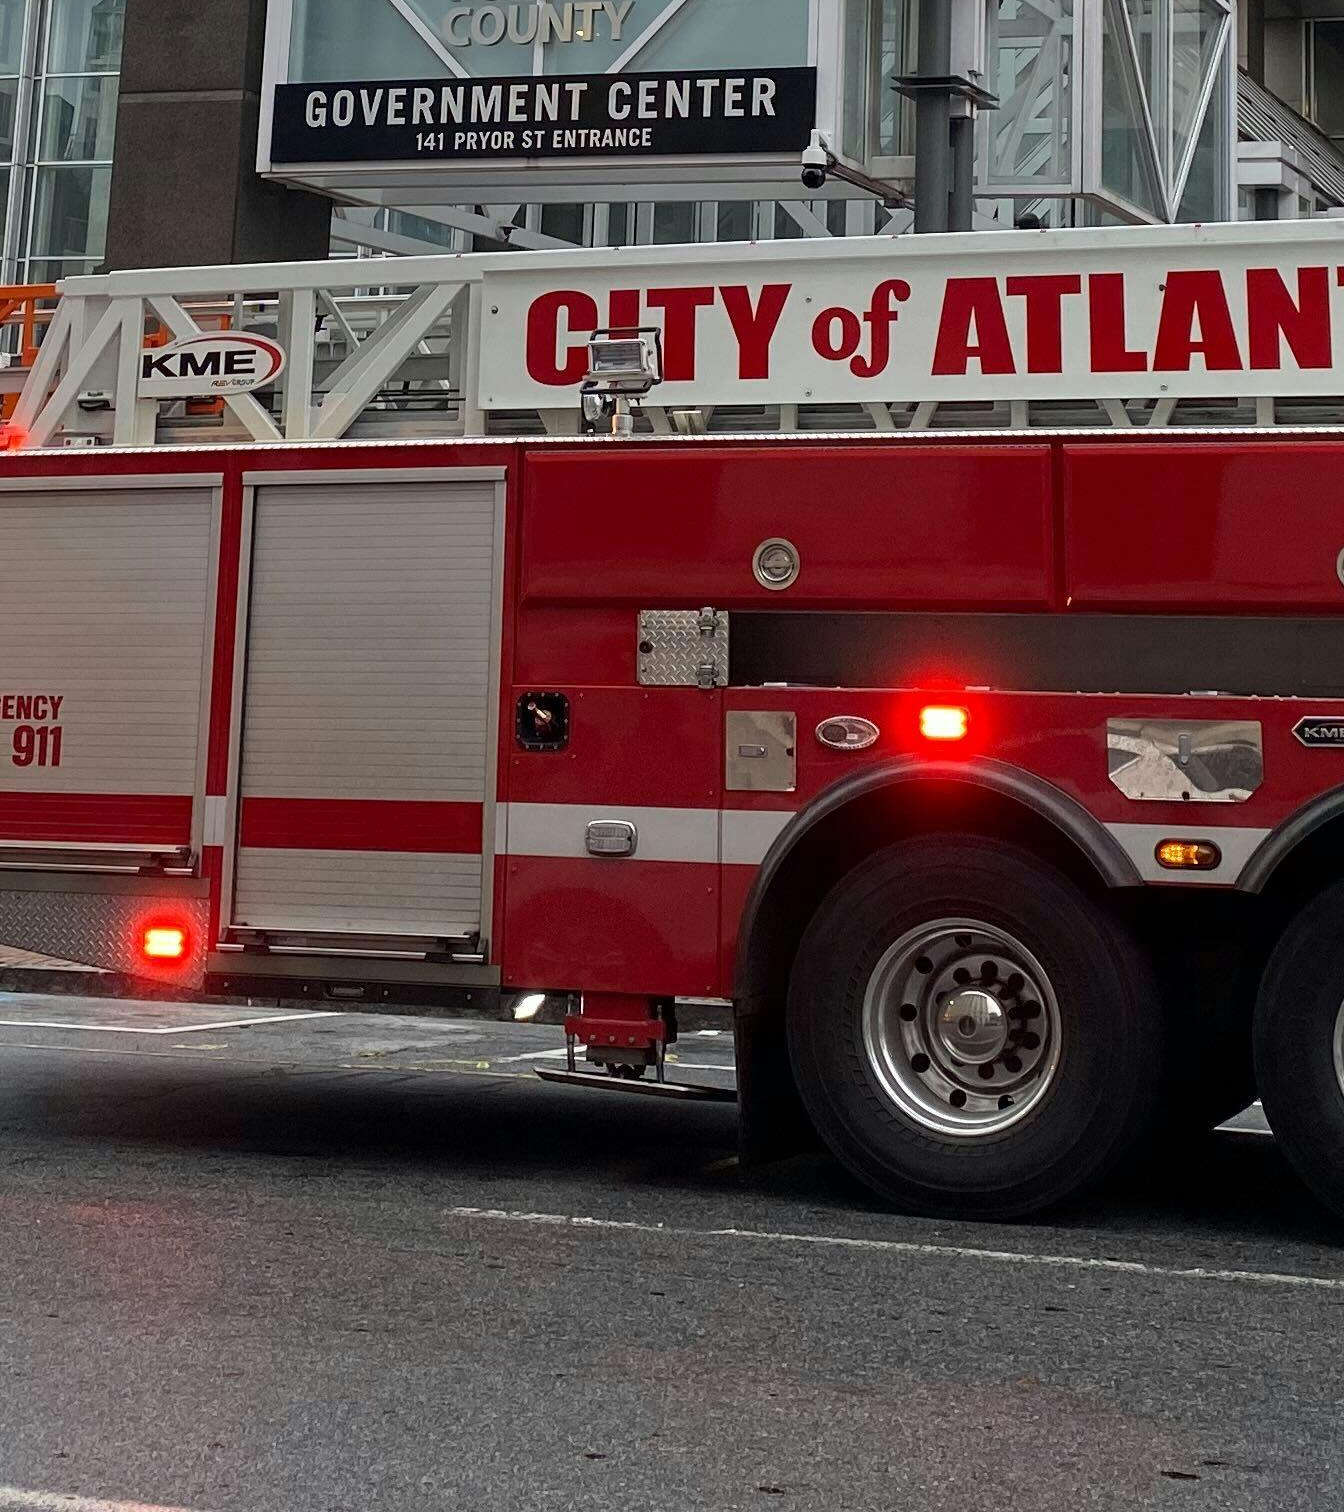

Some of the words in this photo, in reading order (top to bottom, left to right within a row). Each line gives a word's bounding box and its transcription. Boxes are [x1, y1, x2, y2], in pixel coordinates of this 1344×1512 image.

[442, 0, 635, 47] COUNTY
[305, 82, 588, 128] GOVERNMENT
[608, 77, 776, 120] CENTER
[415, 132, 444, 151] 141
[454, 131, 514, 150] PRYOR
[521, 130, 545, 148] ST
[553, 127, 652, 148] ENTRANCE
[811, 279, 911, 378] of
[142, 350, 257, 379] KME
[12, 724, 63, 767] 911
